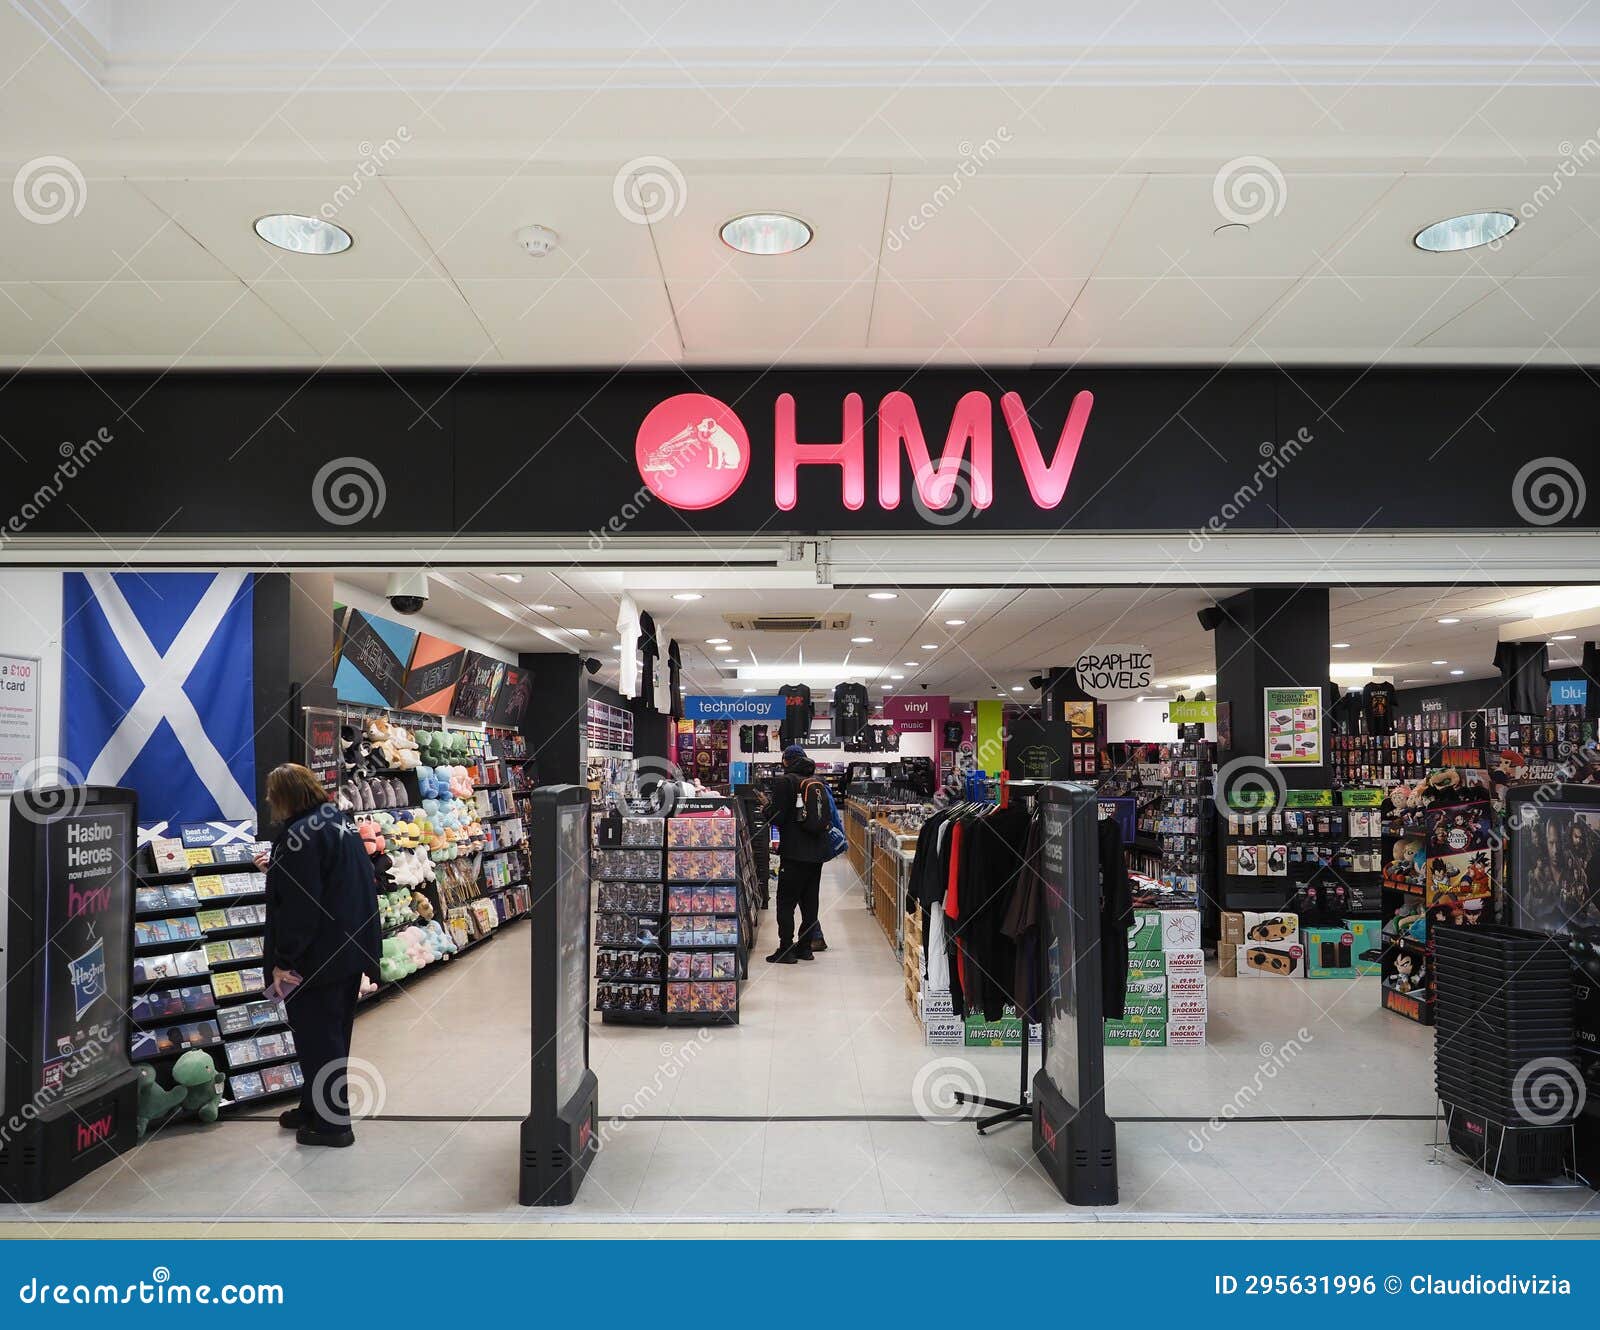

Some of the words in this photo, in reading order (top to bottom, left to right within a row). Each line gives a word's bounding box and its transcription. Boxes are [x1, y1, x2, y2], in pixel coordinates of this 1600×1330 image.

[774, 390, 1095, 511] HMV
[1076, 653, 1152, 672] GRAPHIC
[10, 664, 31, 677] £100
[6, 681, 25, 691] card
[1080, 672, 1150, 689] NOVELS
[699, 700, 772, 714] technology
[904, 702, 928, 713] vinyl
[901, 720, 924, 729] music
[1441, 749, 1480, 767] ANIME
[67, 822, 112, 843] Hasbro
[67, 847, 112, 866] Heroes
[68, 871, 82, 880] now
[83, 868, 106, 878] available
[67, 883, 112, 918] hmv
[1145, 959, 1161, 968] BOX
[1147, 983, 1163, 993] BOX
[1147, 1006, 1162, 1014] BOX
[970, 1029, 1002, 1038] MYSTERY
[1005, 1029, 1021, 1038] BOX
[1108, 1029, 1142, 1038] MYSTERY
[1145, 1029, 1160, 1038] BOX
[78, 1115, 112, 1151] hmv
